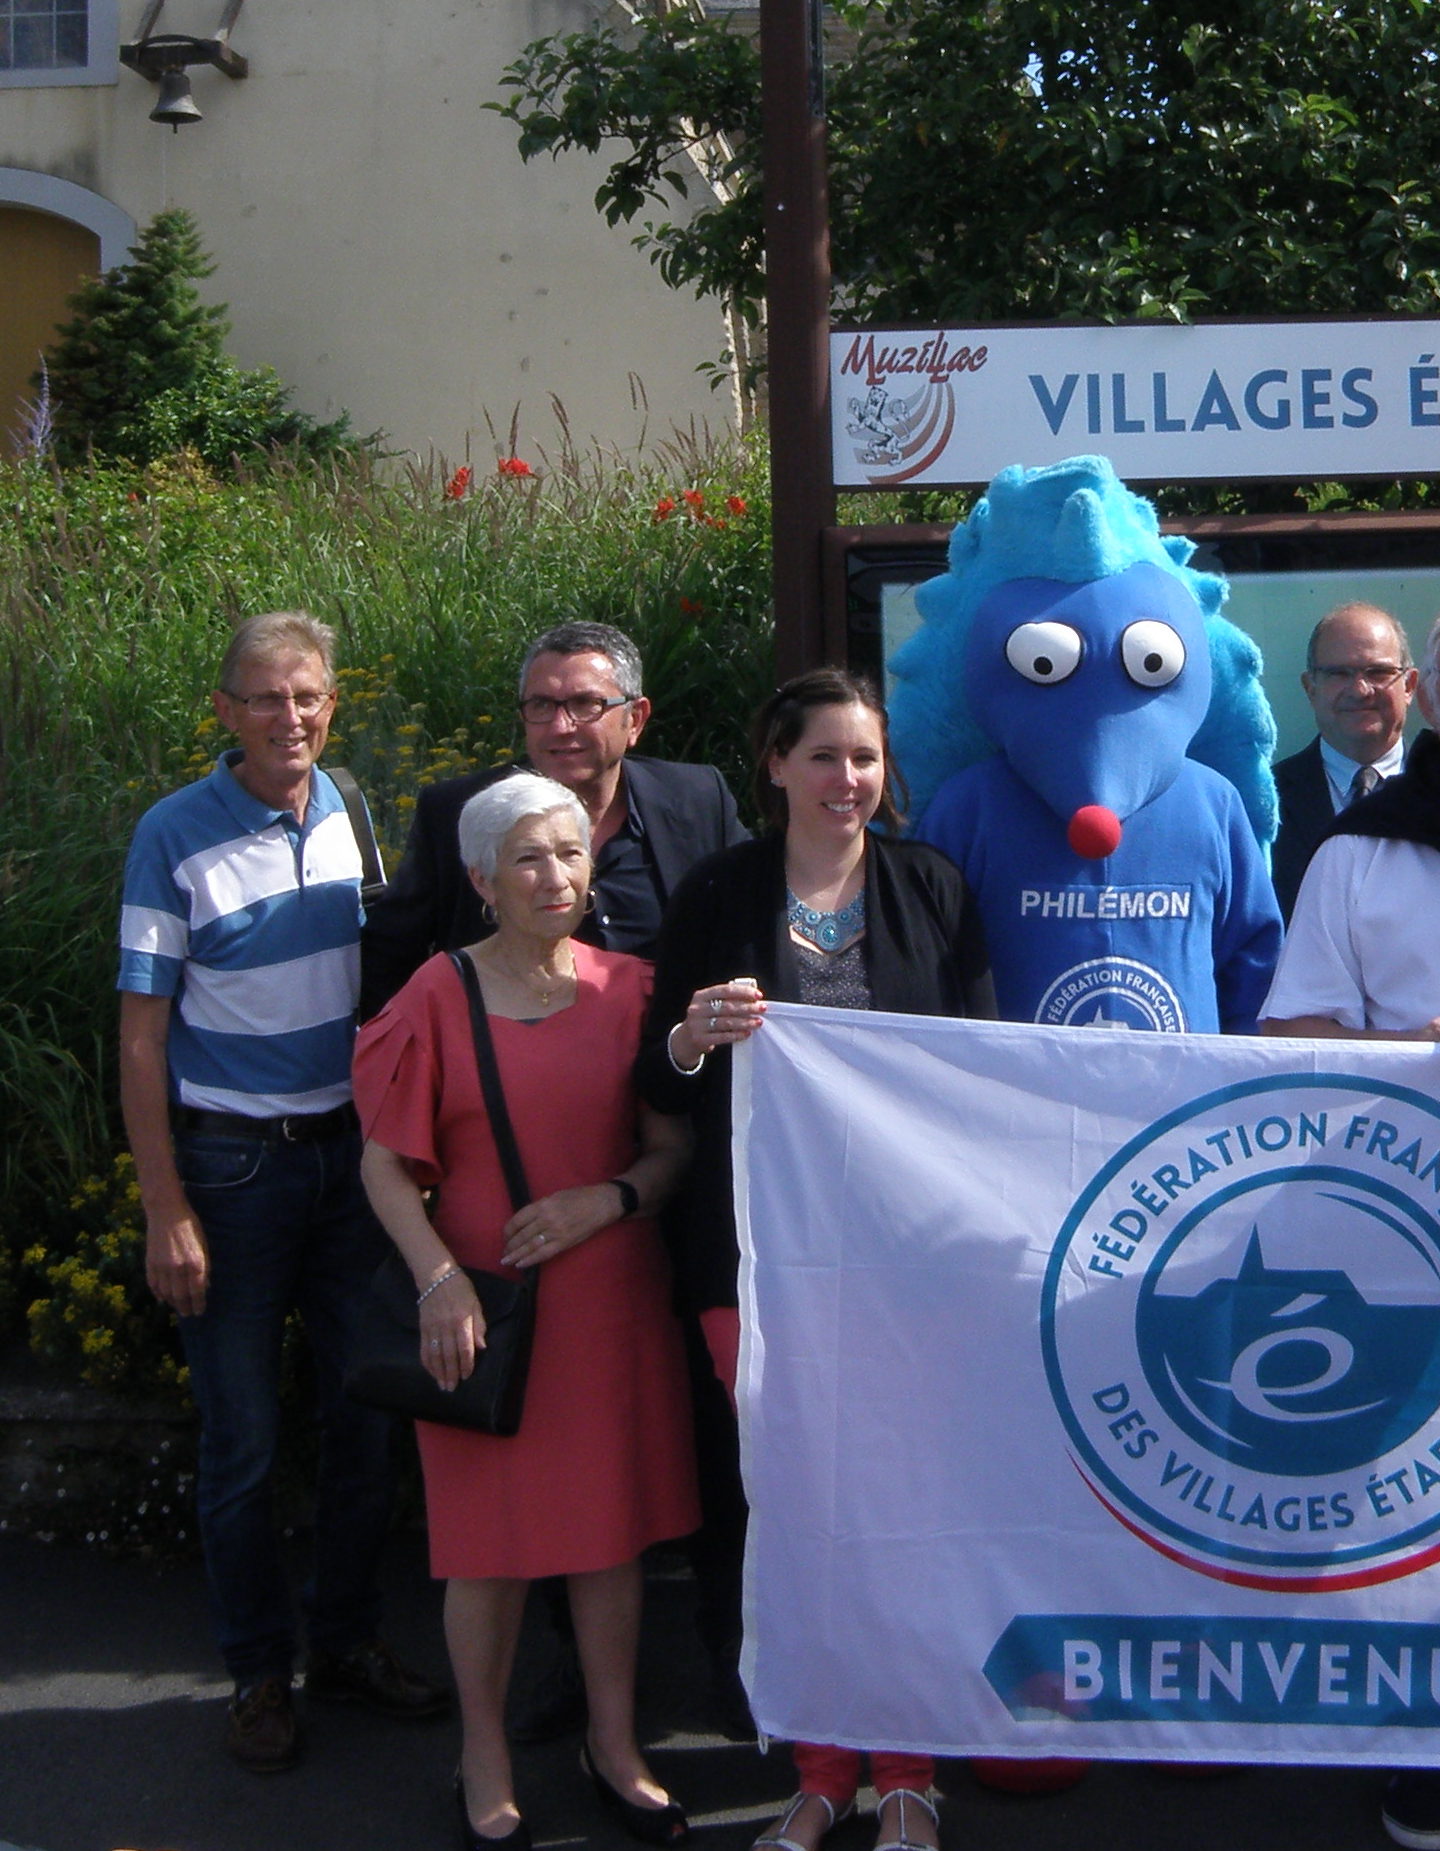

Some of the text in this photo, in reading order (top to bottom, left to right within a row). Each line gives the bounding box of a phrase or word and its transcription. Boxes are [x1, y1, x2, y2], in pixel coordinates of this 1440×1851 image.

[841, 331, 988, 386] Muzillac
[1028, 368, 1378, 435] VILLAGES
[1020, 886, 1191, 919] PHILÉMON
[1047, 969, 1177, 1033] FÉDÉRATION FRANÇAISE
[1088, 1112, 1328, 1280] FÉDÉRATION
[1091, 1381, 1161, 1460] DES
[1158, 1450, 1356, 1533] VILLAGES
